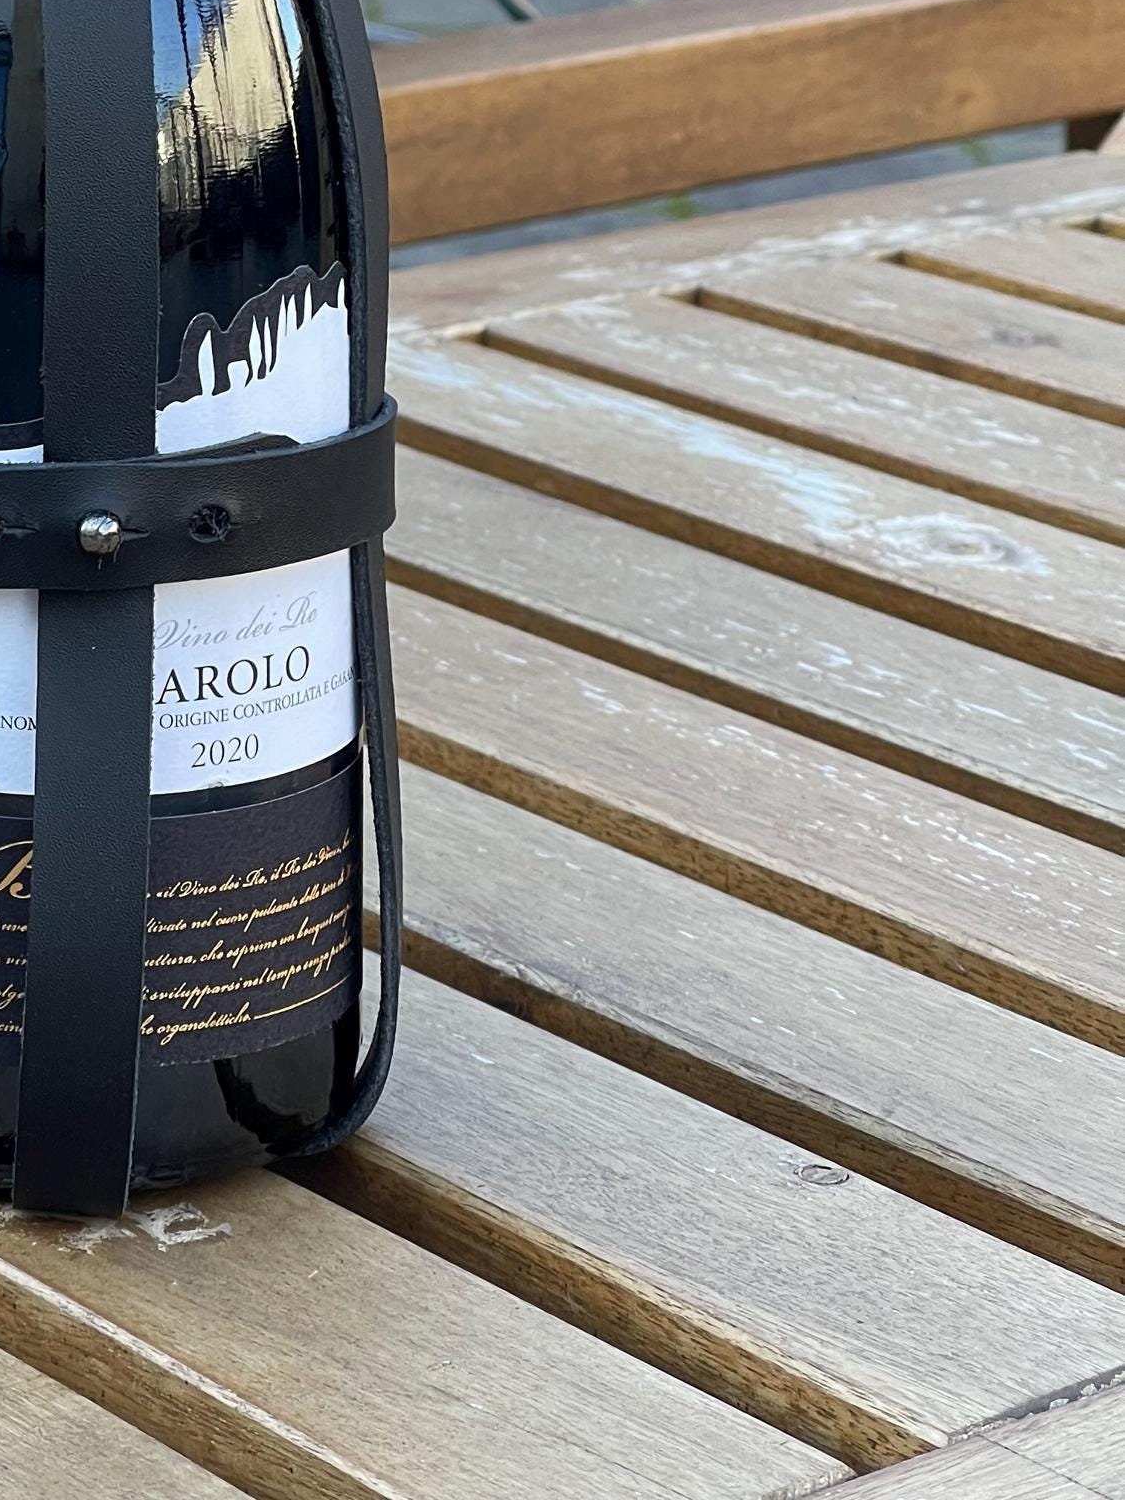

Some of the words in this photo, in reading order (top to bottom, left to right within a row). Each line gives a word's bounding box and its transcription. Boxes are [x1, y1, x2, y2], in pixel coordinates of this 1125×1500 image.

[154, 618, 228, 650] Vino
[236, 605, 277, 641] dei
[279, 591, 318, 632] Re
[155, 645, 310, 705] AROLO
[159, 708, 229, 729] ORIGINE
[233, 686, 322, 720] CONTROLLATA
[324, 680, 329, 695] E
[191, 733, 260, 768] 2020
[179, 880, 215, 897] Vino
[219, 874, 242, 892] dei
[200, 940, 223, 962] che
[150, 977, 242, 1009] svilupparsi
